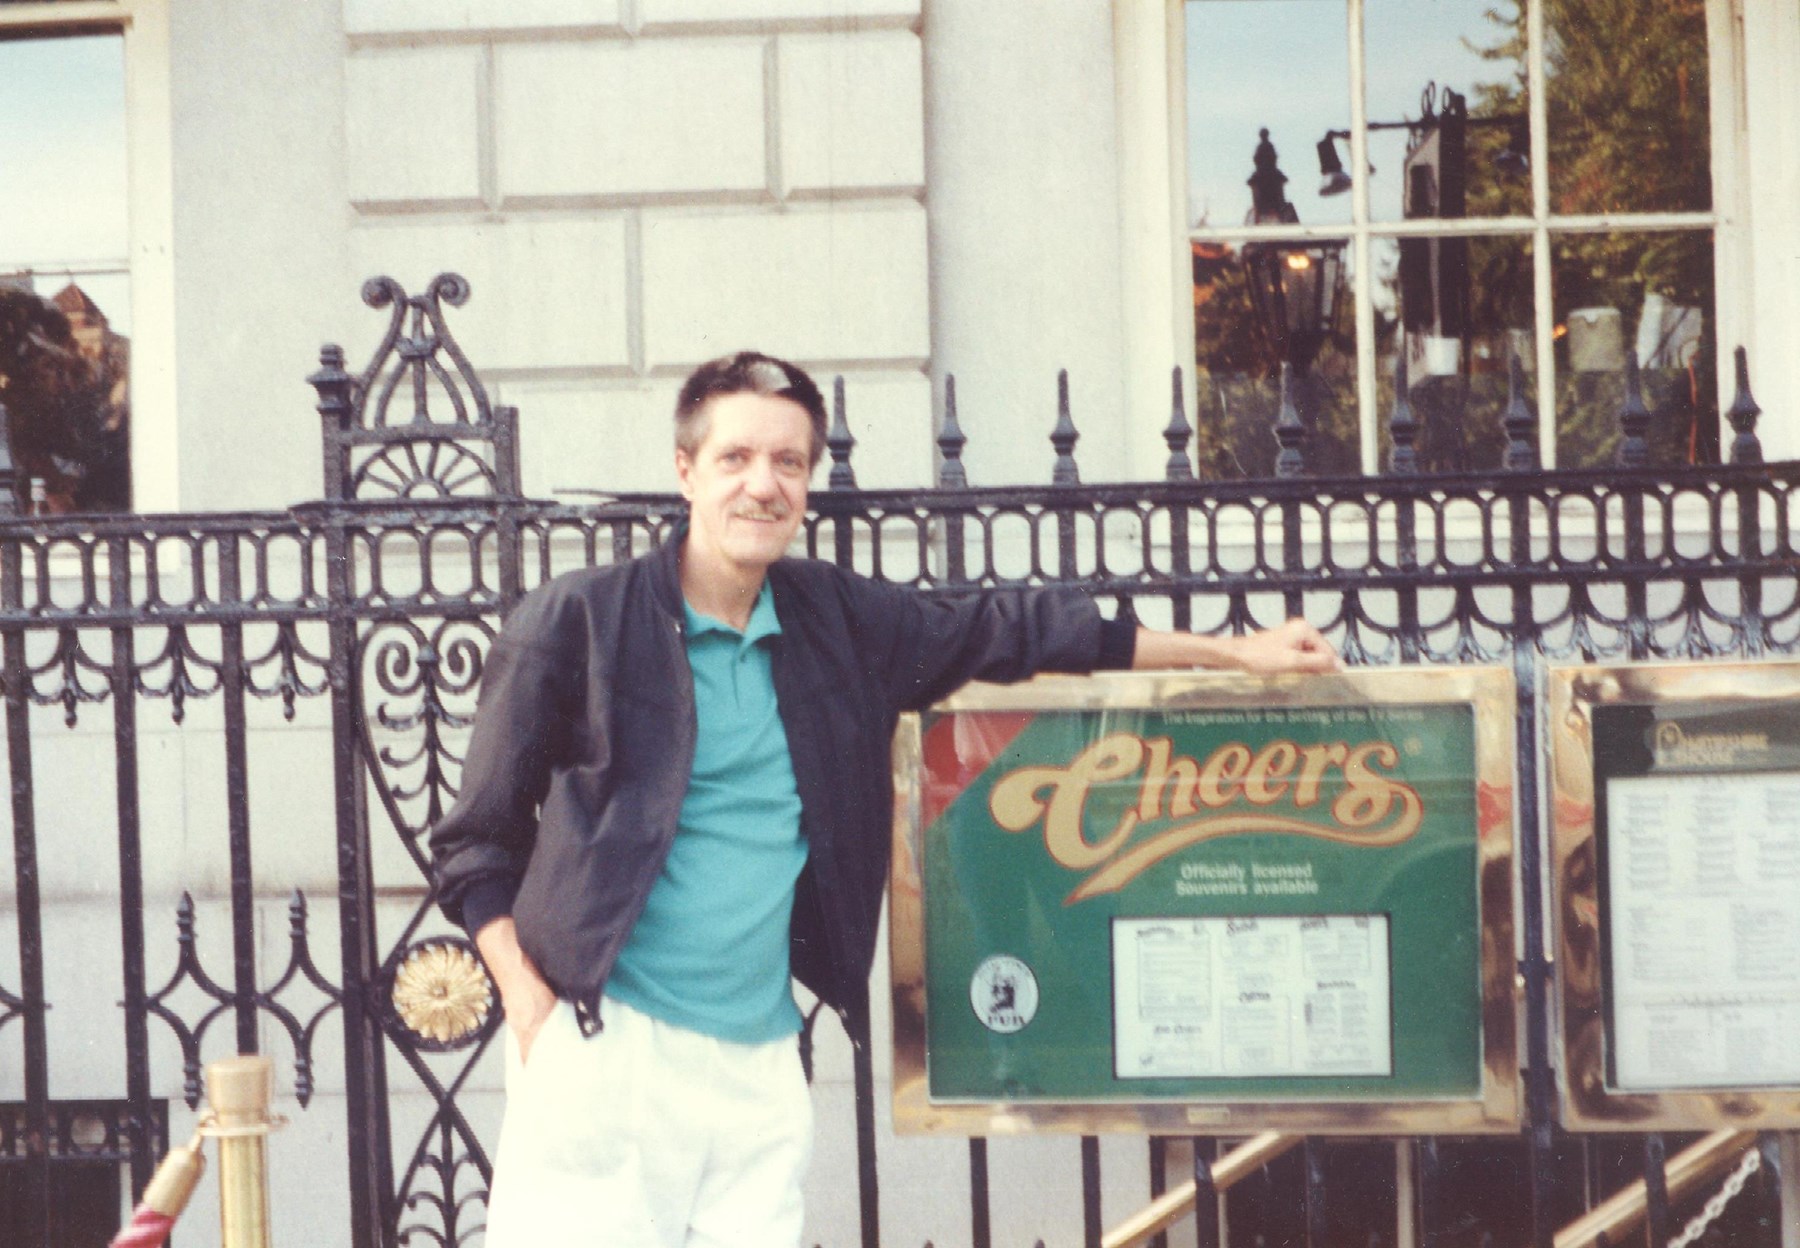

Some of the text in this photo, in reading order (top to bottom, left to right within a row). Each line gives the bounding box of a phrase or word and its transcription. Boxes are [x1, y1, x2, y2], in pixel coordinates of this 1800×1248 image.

[988, 732, 1424, 906] Cheers
[1180, 862, 1313, 882] Officially licensed
[1175, 879, 1319, 896] Souvenirs available
